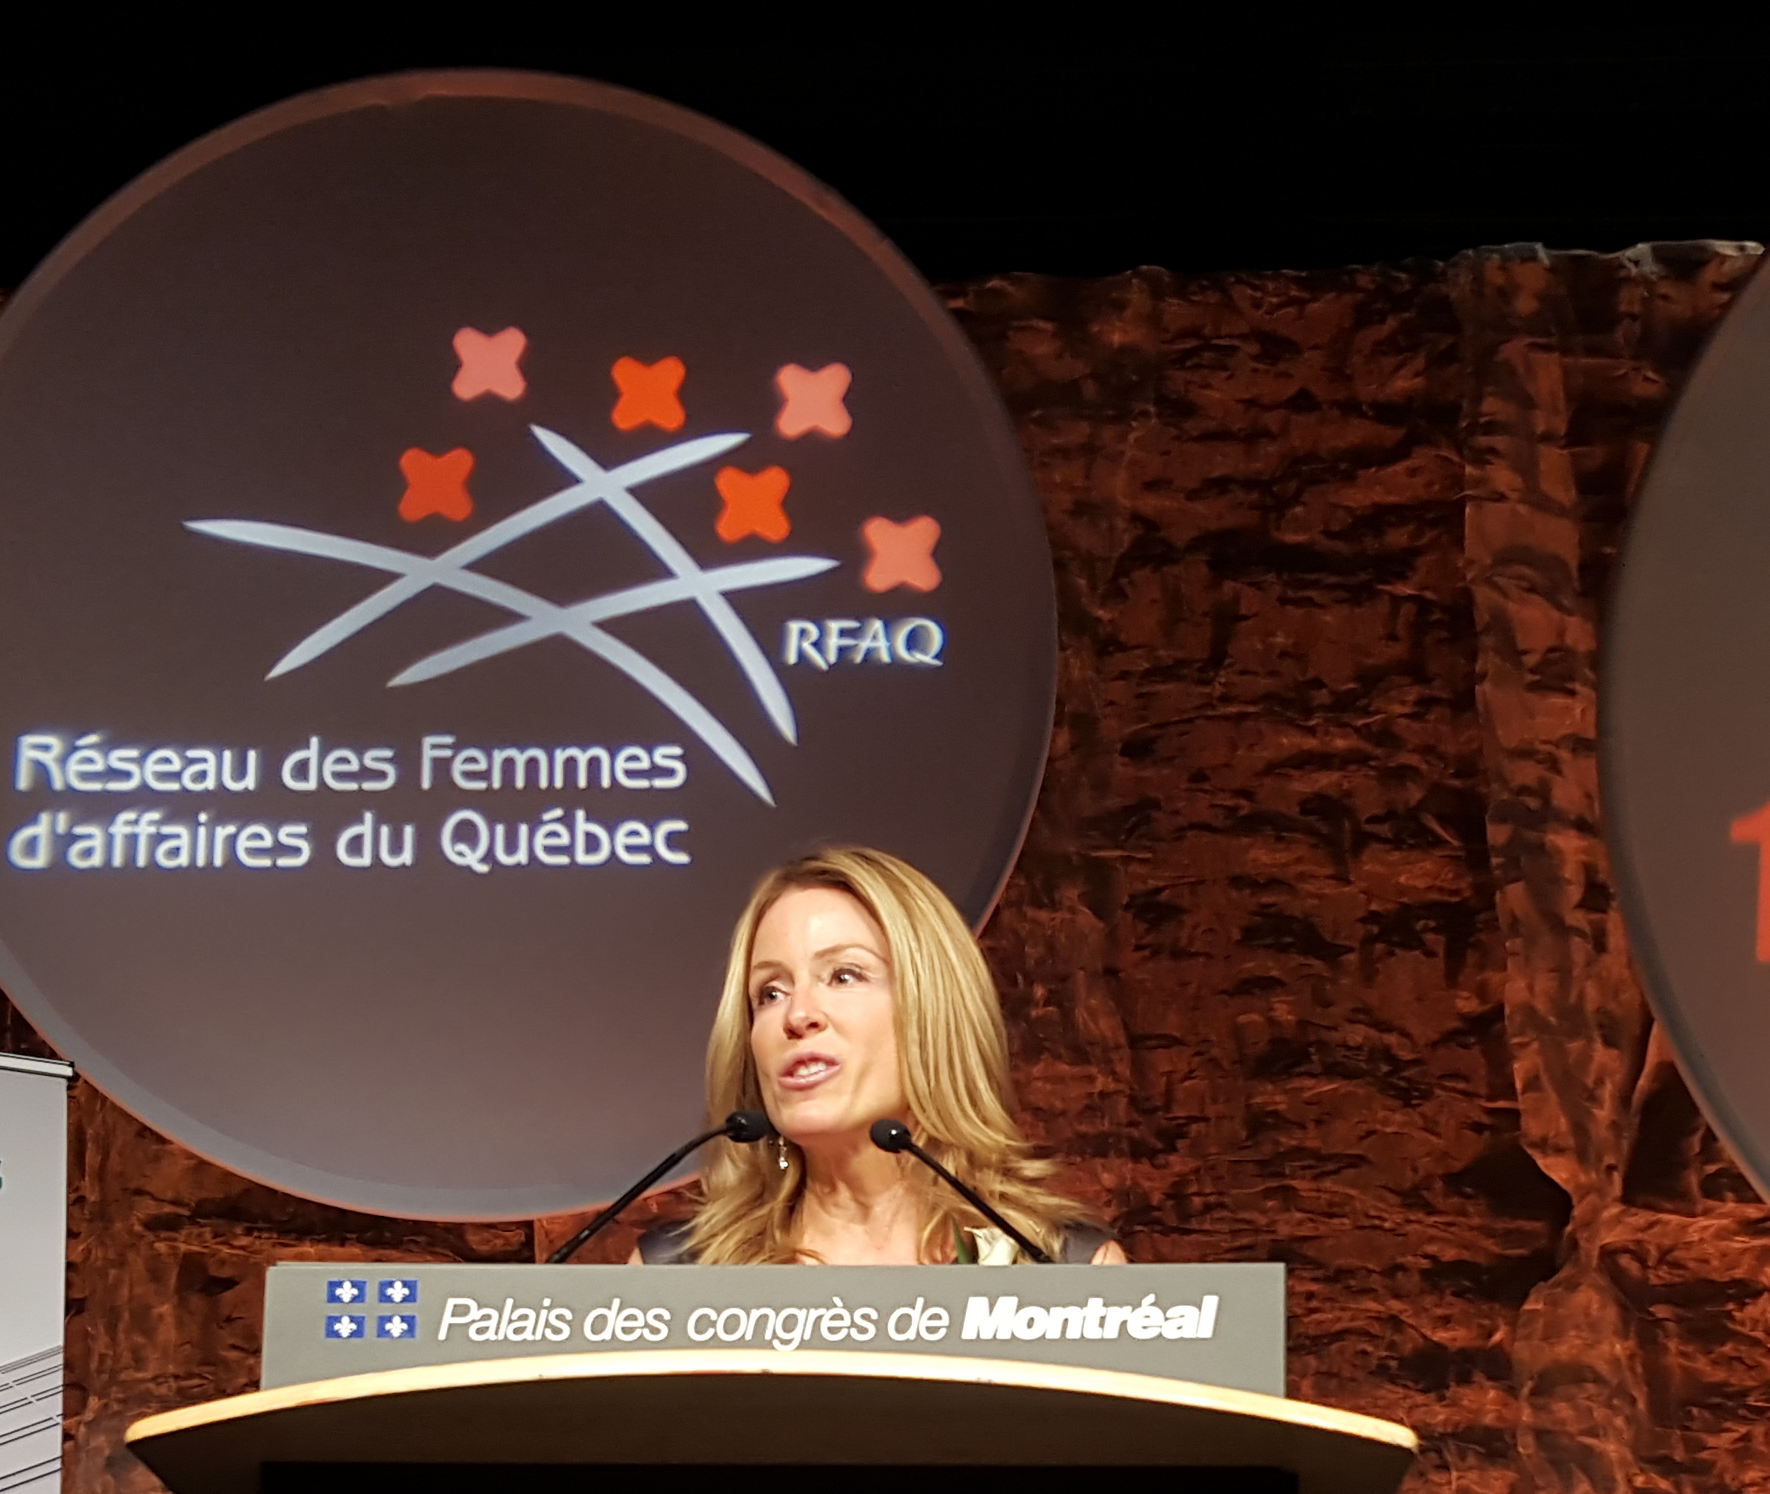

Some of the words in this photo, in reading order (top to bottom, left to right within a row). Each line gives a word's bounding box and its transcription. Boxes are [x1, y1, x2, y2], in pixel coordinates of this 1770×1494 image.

[782, 617, 945, 669] RFAQ
[13, 732, 259, 793] Réseau
[280, 734, 398, 792] des
[419, 734, 688, 792] Femmes
[6, 808, 313, 872] d'affaires
[334, 809, 416, 869] du
[439, 807, 692, 875] Québec
[436, 1297, 574, 1343] Palais
[582, 1297, 671, 1343] des
[684, 1295, 880, 1353] congrès
[886, 1296, 951, 1342] de
[959, 1292, 1220, 1342] Montréal
